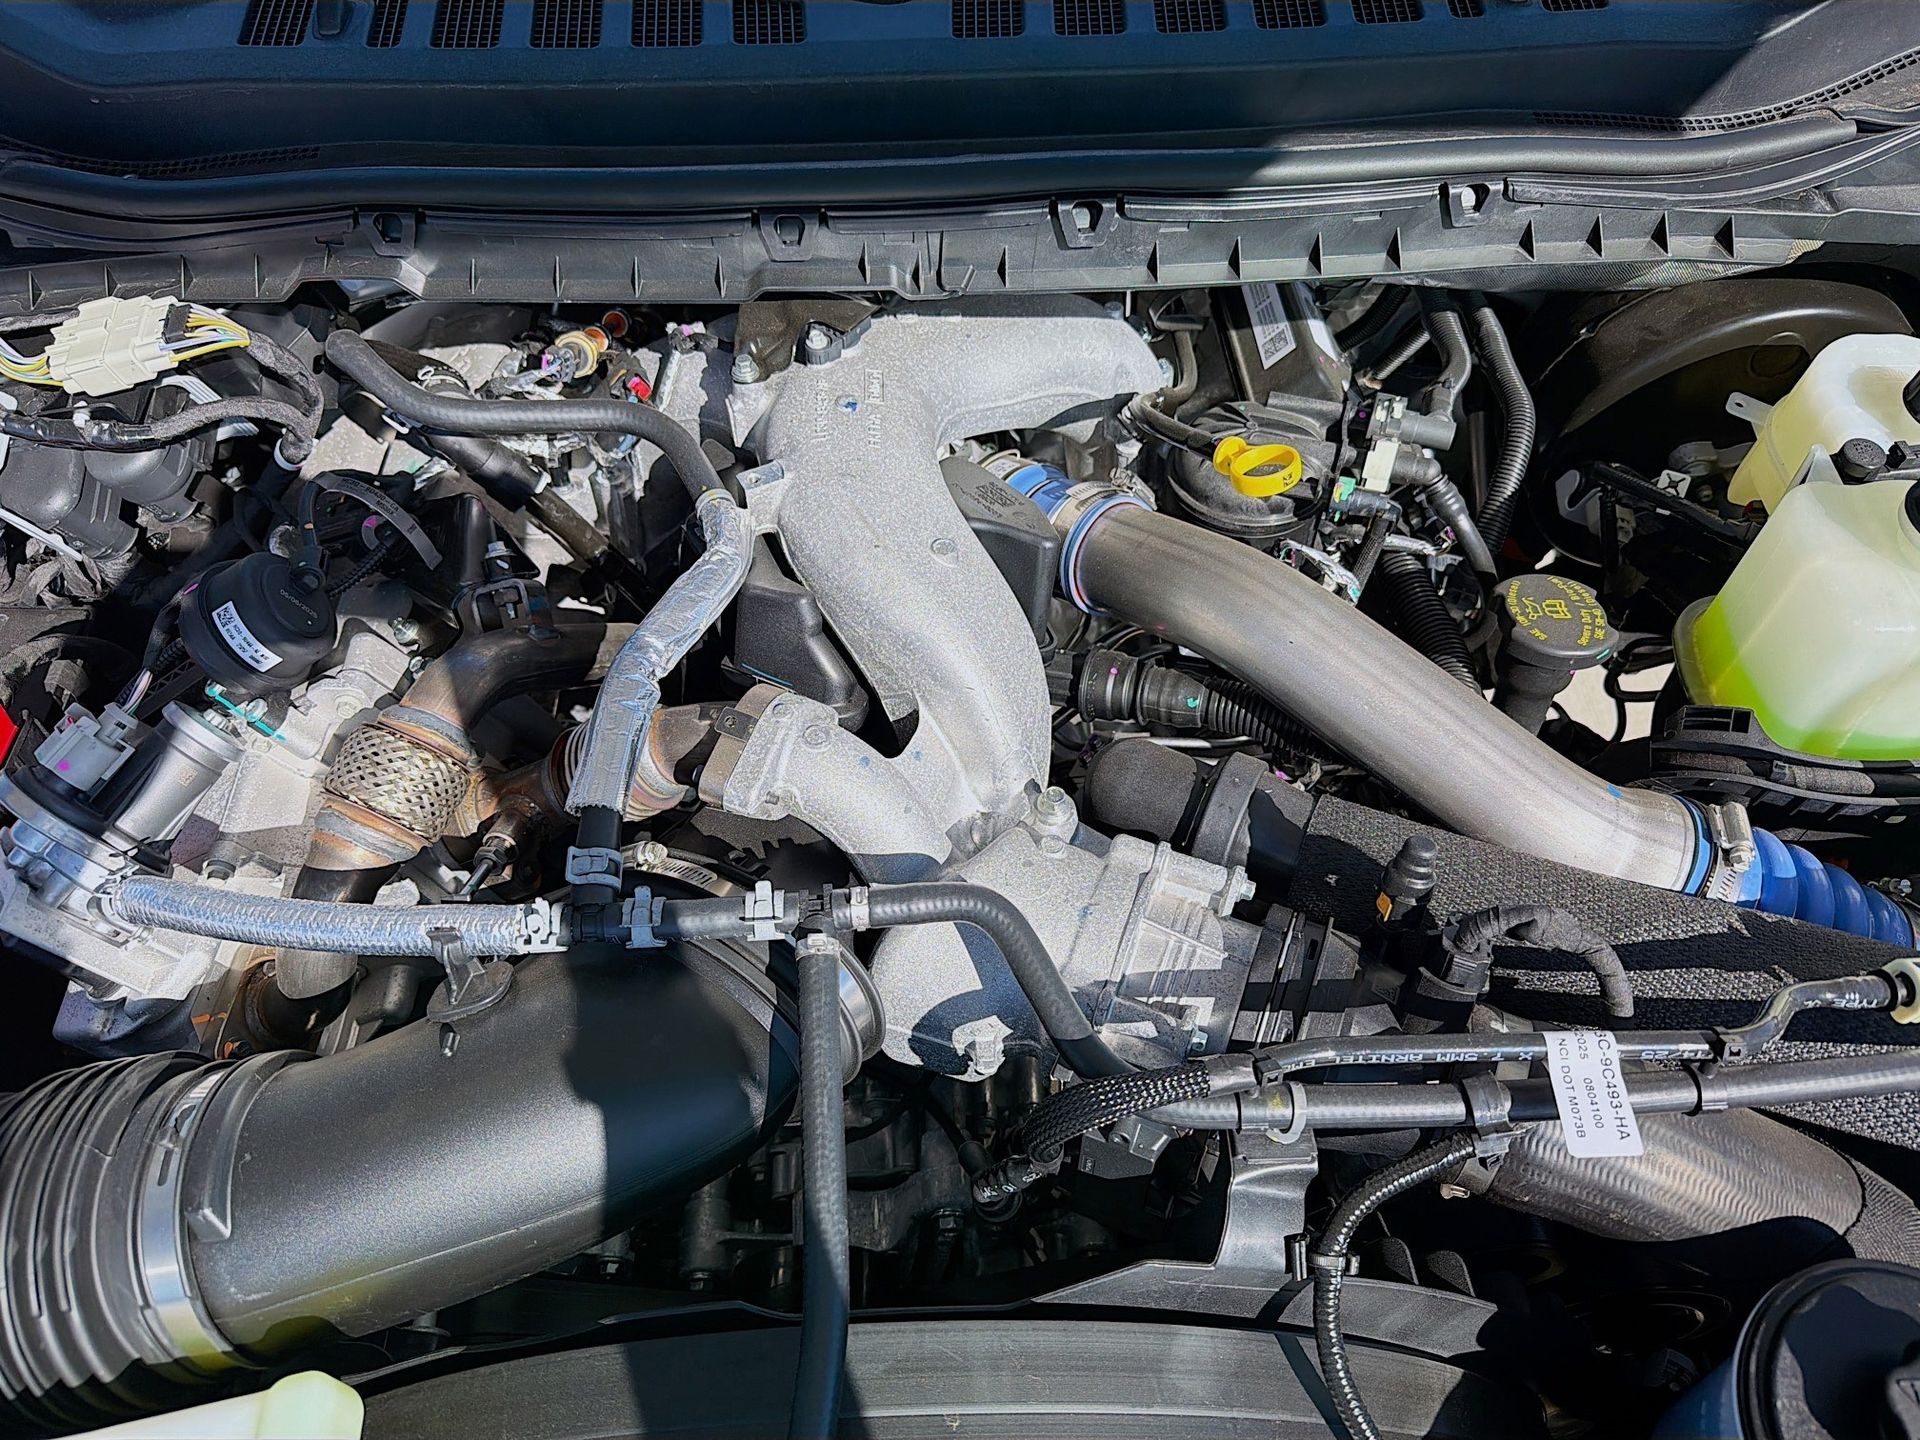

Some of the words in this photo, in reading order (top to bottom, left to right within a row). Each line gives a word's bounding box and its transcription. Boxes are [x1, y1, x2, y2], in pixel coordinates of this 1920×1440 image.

[1580, 609, 1592, 624] Duty
[1530, 628, 1548, 641] SAE
[1577, 625, 1592, 646] Severe
[1593, 627, 1606, 640] SAE
[1436, 1052, 1505, 1062] 7.5MM
[1519, 1052, 1534, 1061] X
[1556, 1038, 1569, 1061] NCI
[1328, 1053, 1423, 1065] ARNITEL
[1561, 1065, 1575, 1093] DOT
[1583, 1077, 1605, 1129] 0804100
[1568, 1095, 1586, 1139] M073B
